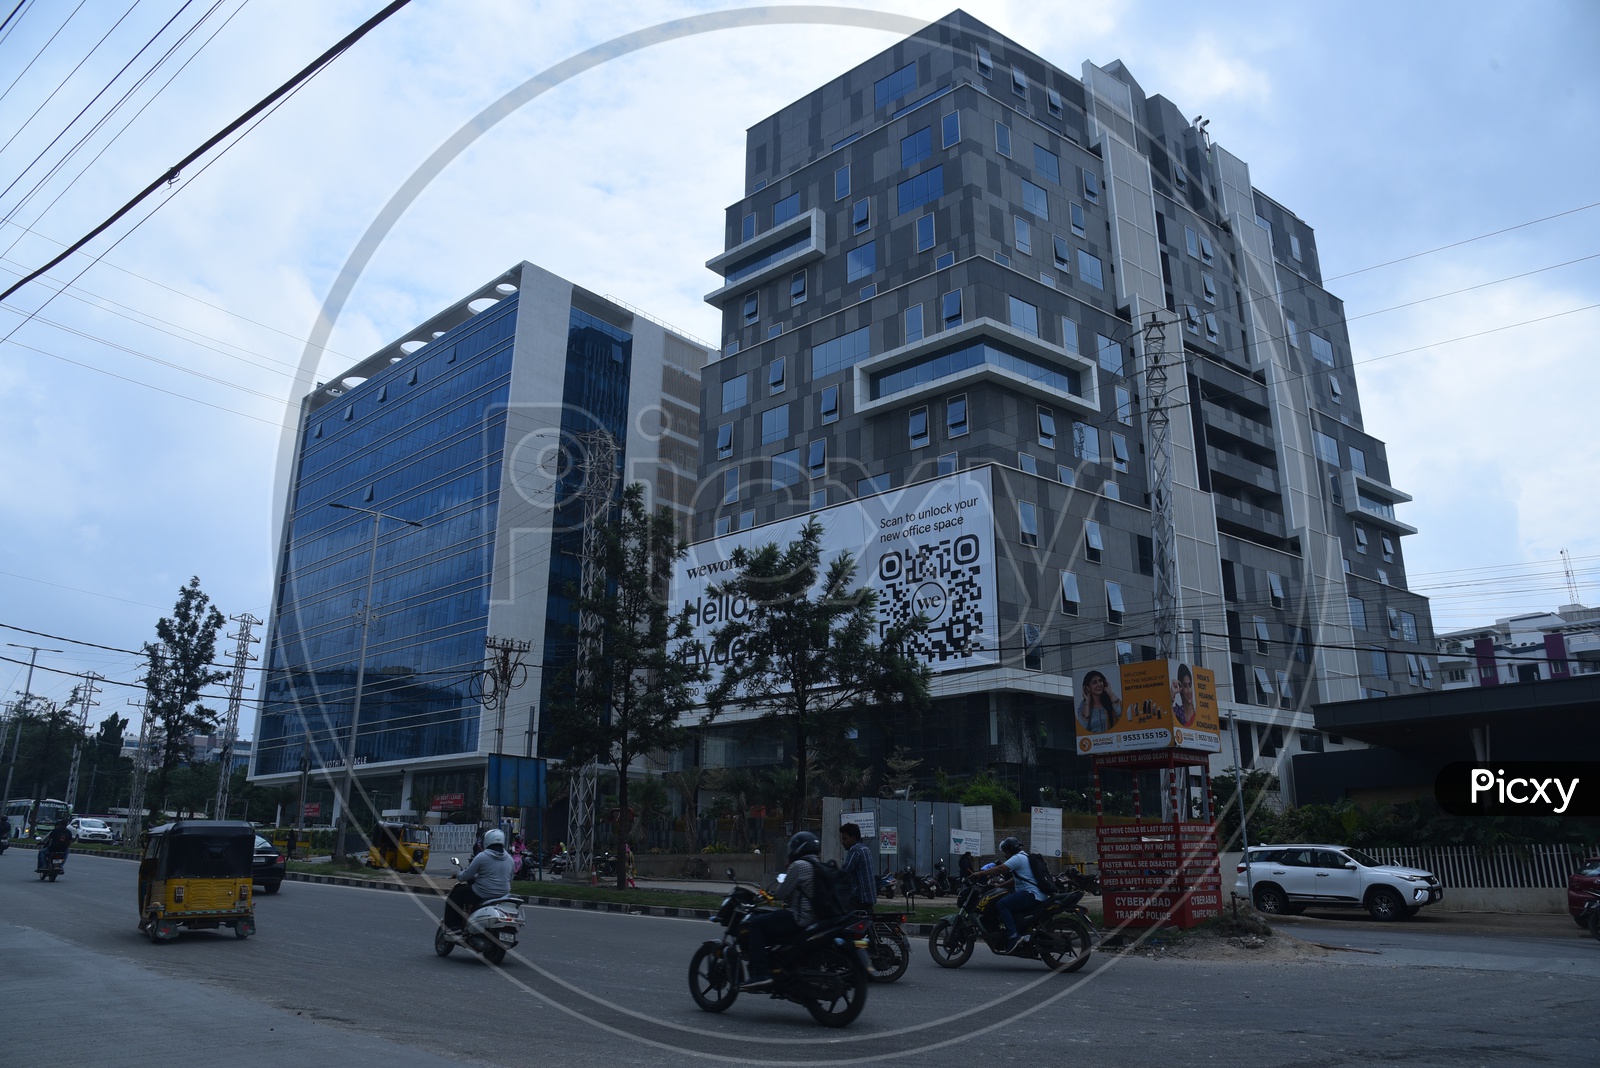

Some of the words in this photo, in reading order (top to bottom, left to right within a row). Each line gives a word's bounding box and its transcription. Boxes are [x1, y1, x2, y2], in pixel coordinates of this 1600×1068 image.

[880, 516, 903, 529] Scan
[905, 512, 916, 523] to
[918, 502, 952, 520] unlock
[954, 497, 979, 514] your
[880, 530, 901, 543] new
[902, 524, 931, 538] office
[933, 516, 964, 532] space
[915, 592, 941, 611] we
[685, 592, 755, 627] Hello,
[1197, 682, 1207, 690] BEST
[1198, 692, 1215, 701] HEARING
[1199, 701, 1209, 709] CARE
[1196, 721, 1218, 731] KONDAPUR
[1122, 732, 1141, 742] 9533
[1142, 731, 1154, 740] 155
[1156, 730, 1168, 738] 155
[341, 756, 367, 767] PIACLE
[1152, 752, 1169, 760] DEATH
[1115, 897, 1171, 907] CYBERABAD
[1190, 894, 1217, 906] CYBERABAD
[1115, 910, 1145, 919] TRAFFIC
[1146, 910, 1171, 921] POLICE
[1191, 909, 1206, 919] TRAFFIC
